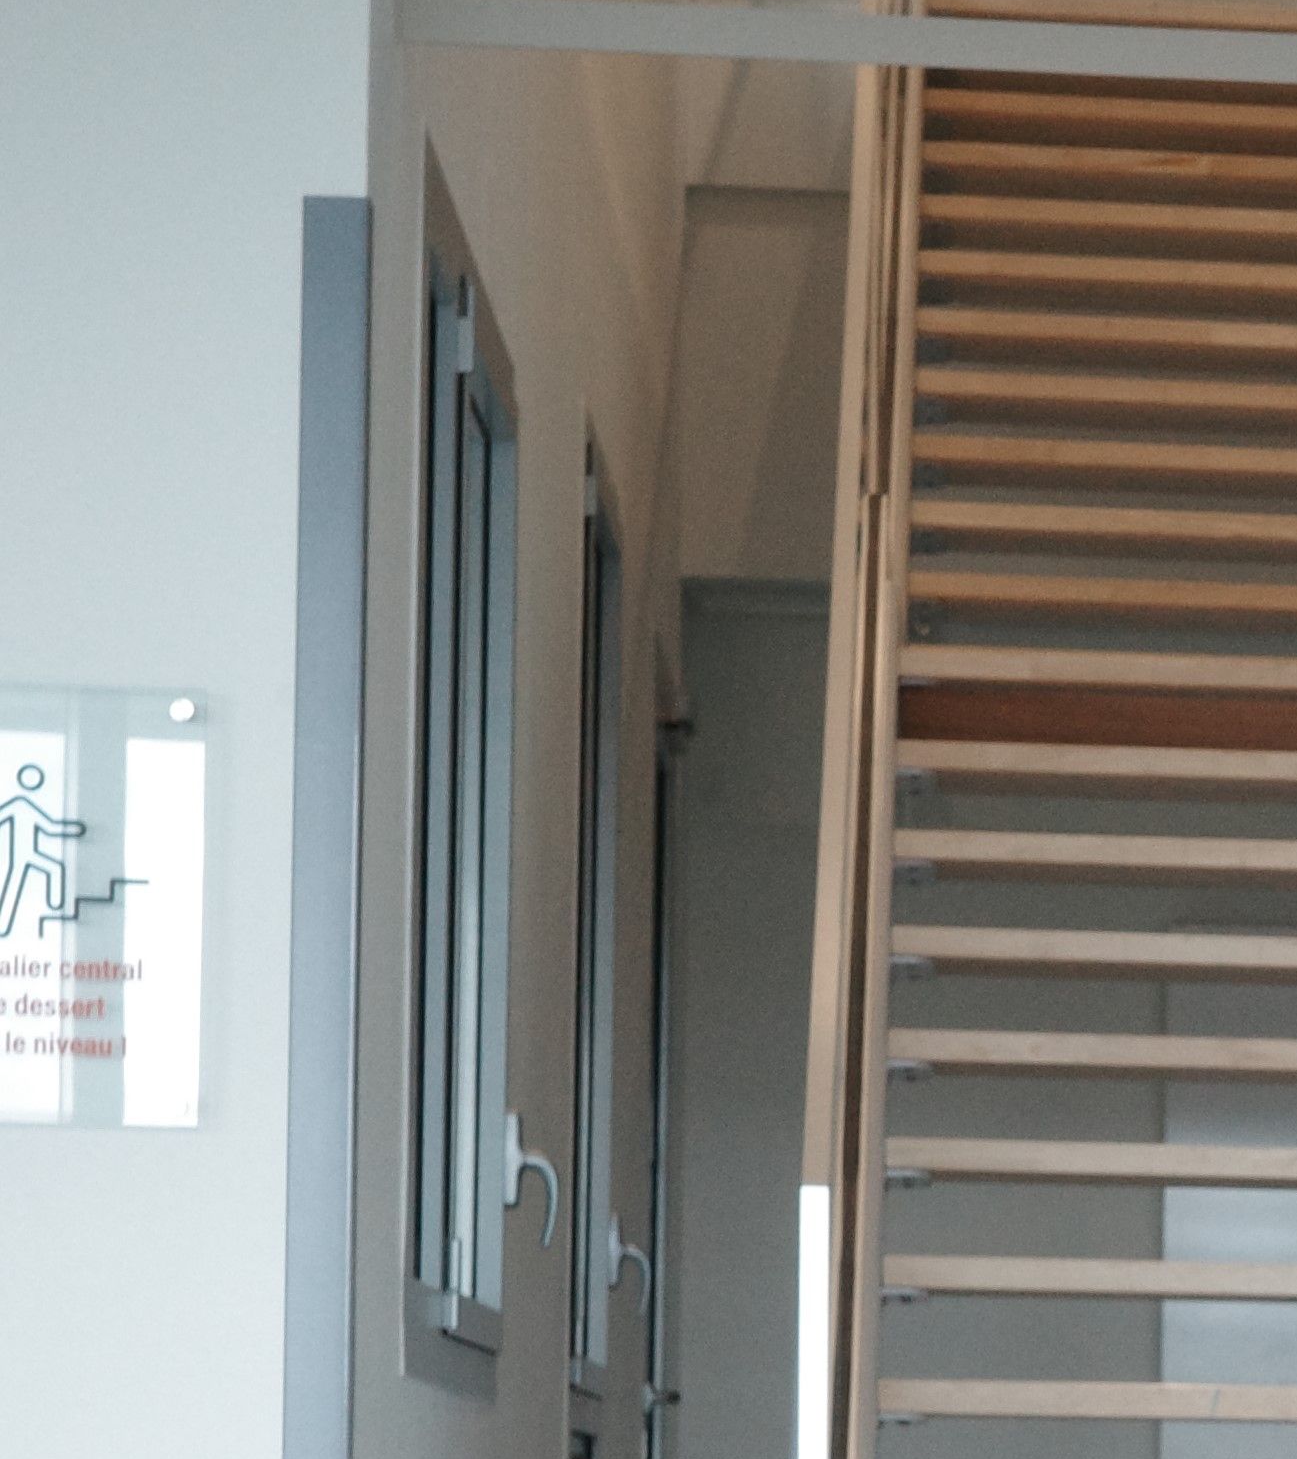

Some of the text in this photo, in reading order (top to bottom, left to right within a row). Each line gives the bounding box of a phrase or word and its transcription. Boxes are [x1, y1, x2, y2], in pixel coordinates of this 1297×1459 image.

[60, 957, 142, 981] central
[14, 993, 105, 1019] dessert
[6, 1031, 26, 1054] le
[34, 1034, 112, 1058] niveau
